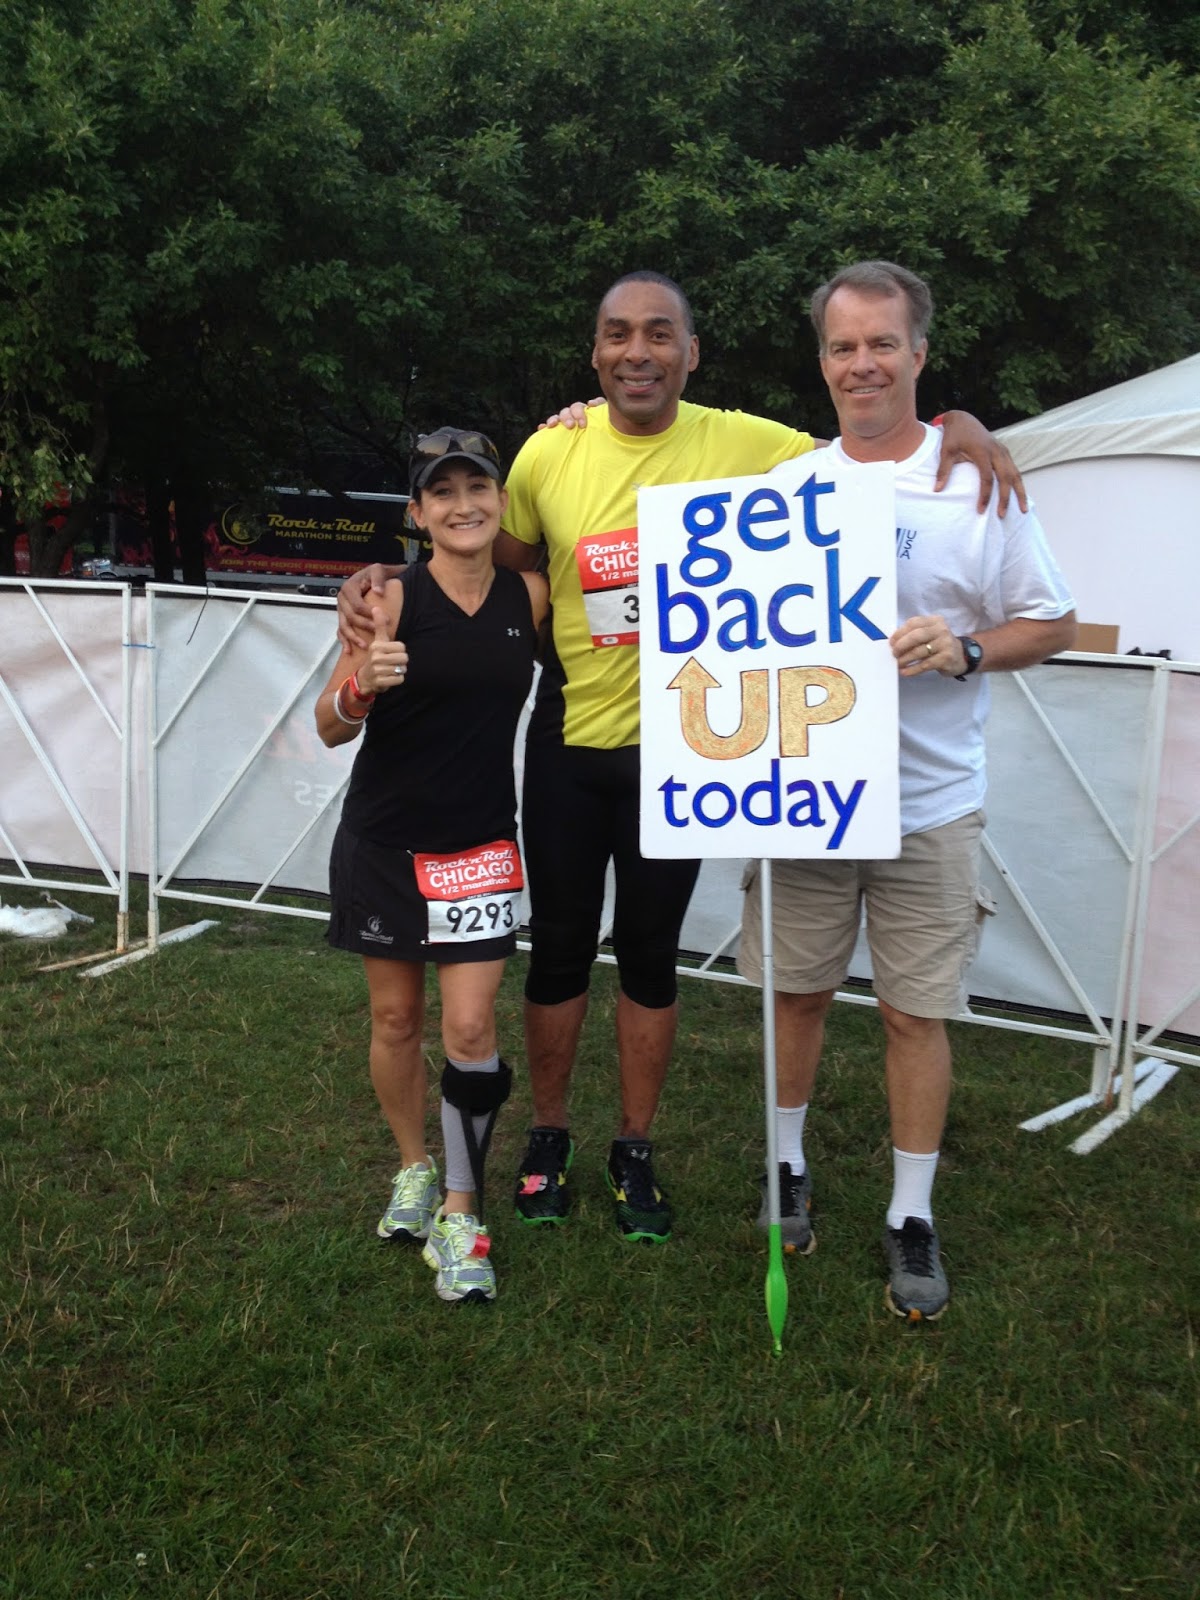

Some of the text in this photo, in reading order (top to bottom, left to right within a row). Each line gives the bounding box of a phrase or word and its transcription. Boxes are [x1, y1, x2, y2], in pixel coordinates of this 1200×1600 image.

[267, 513, 317, 530] Rock
[335, 517, 376, 534] Roll
[275, 530, 369, 543] MARATHON SERIES
[680, 472, 841, 588] get
[584, 540, 631, 557] Rock
[899, 529, 917, 560] USA
[220, 558, 244, 566] JOIN
[247, 559, 268, 567] THE
[271, 561, 303, 569] ROCK
[601, 571, 620, 582] 1/2
[655, 548, 888, 655] back
[666, 655, 857, 760] UP
[657, 758, 868, 850] today
[424, 857, 468, 873] Rock
[481, 848, 513, 861] Roll
[429, 860, 514, 888] CHICAGO
[441, 877, 510, 896] 1/2 marathon
[446, 899, 513, 934] 9293
